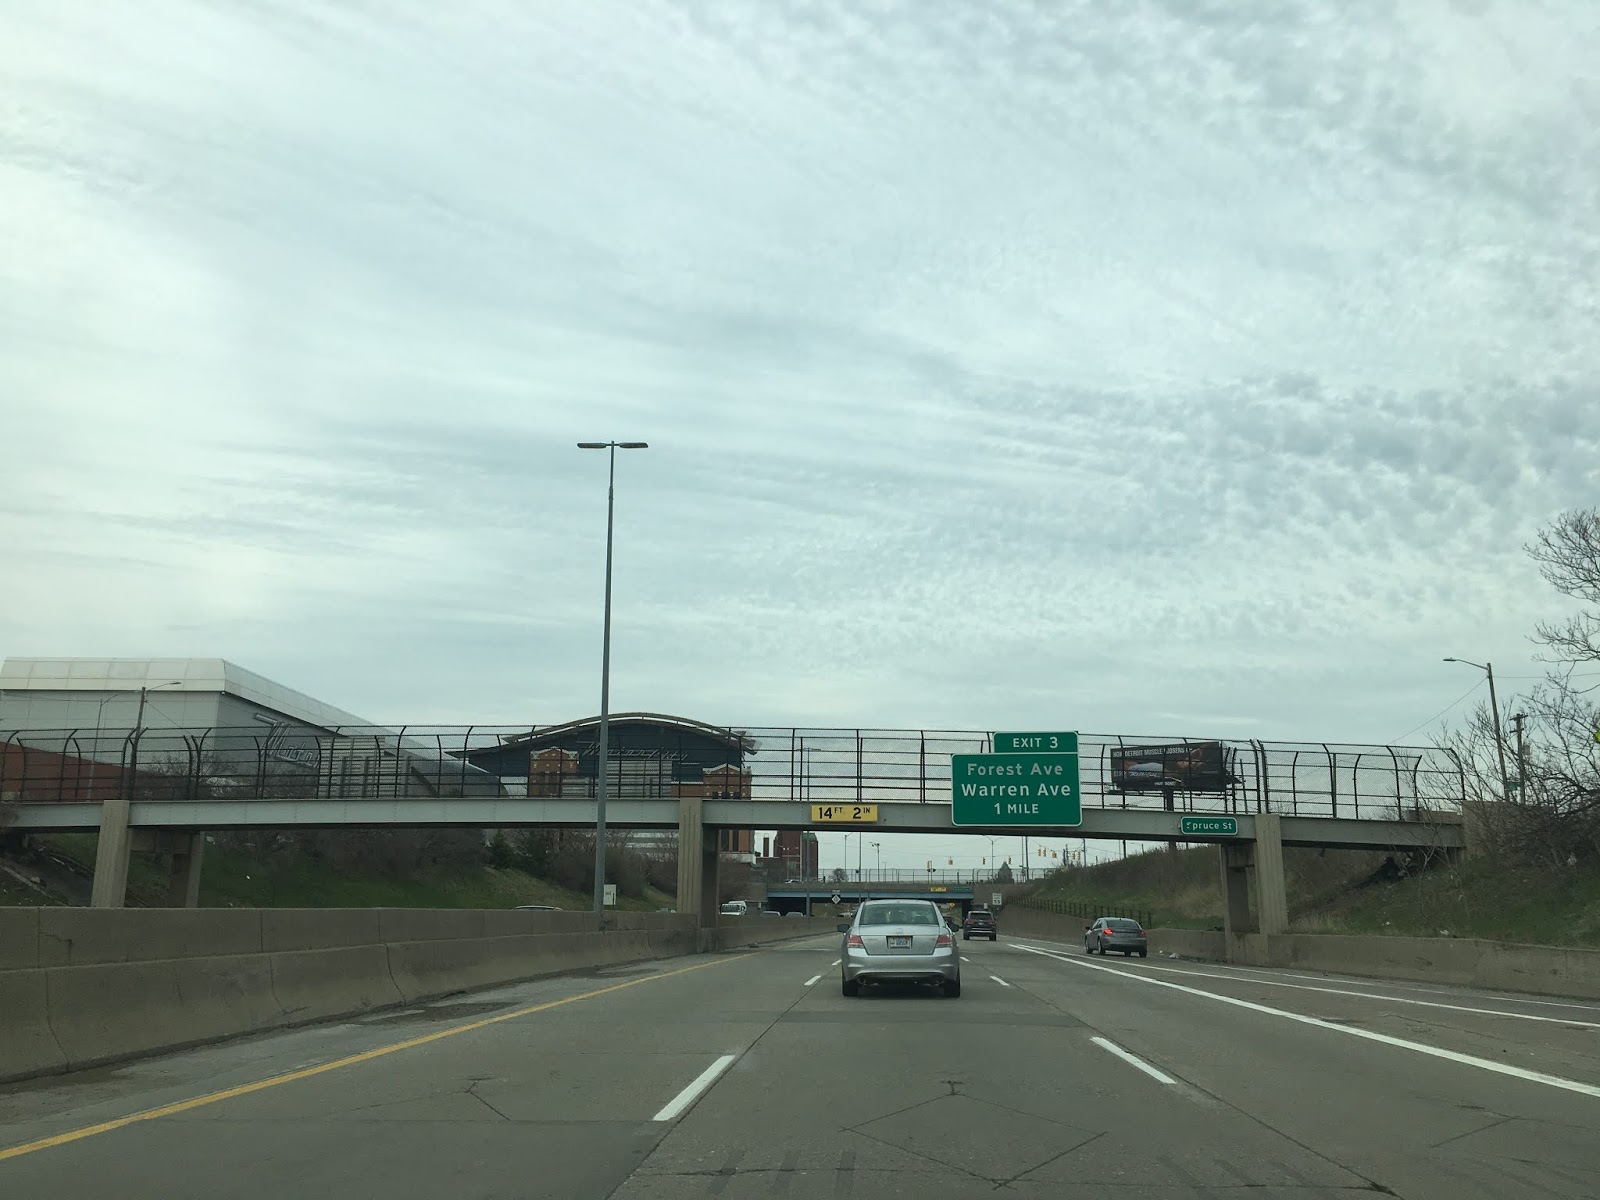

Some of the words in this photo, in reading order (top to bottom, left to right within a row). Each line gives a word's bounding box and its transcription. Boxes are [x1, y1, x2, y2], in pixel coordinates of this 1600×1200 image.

[1013, 737, 1042, 748] EXIT
[1049, 736, 1058, 749] 3
[1124, 749, 1143, 757] DETROIT
[1144, 748, 1163, 756] MUSCLE
[967, 763, 1022, 776] Forest
[1030, 762, 1063, 776] Ave
[961, 783, 1030, 797] Warren
[1037, 783, 1071, 796] Ave
[818, 806, 833, 819] 14
[834, 806, 843, 814] FT
[852, 806, 862, 819] 2
[863, 806, 871, 814] IN
[994, 803, 1001, 815] 1
[1007, 803, 1039, 814] MILE
[1222, 822, 1233, 830] St
